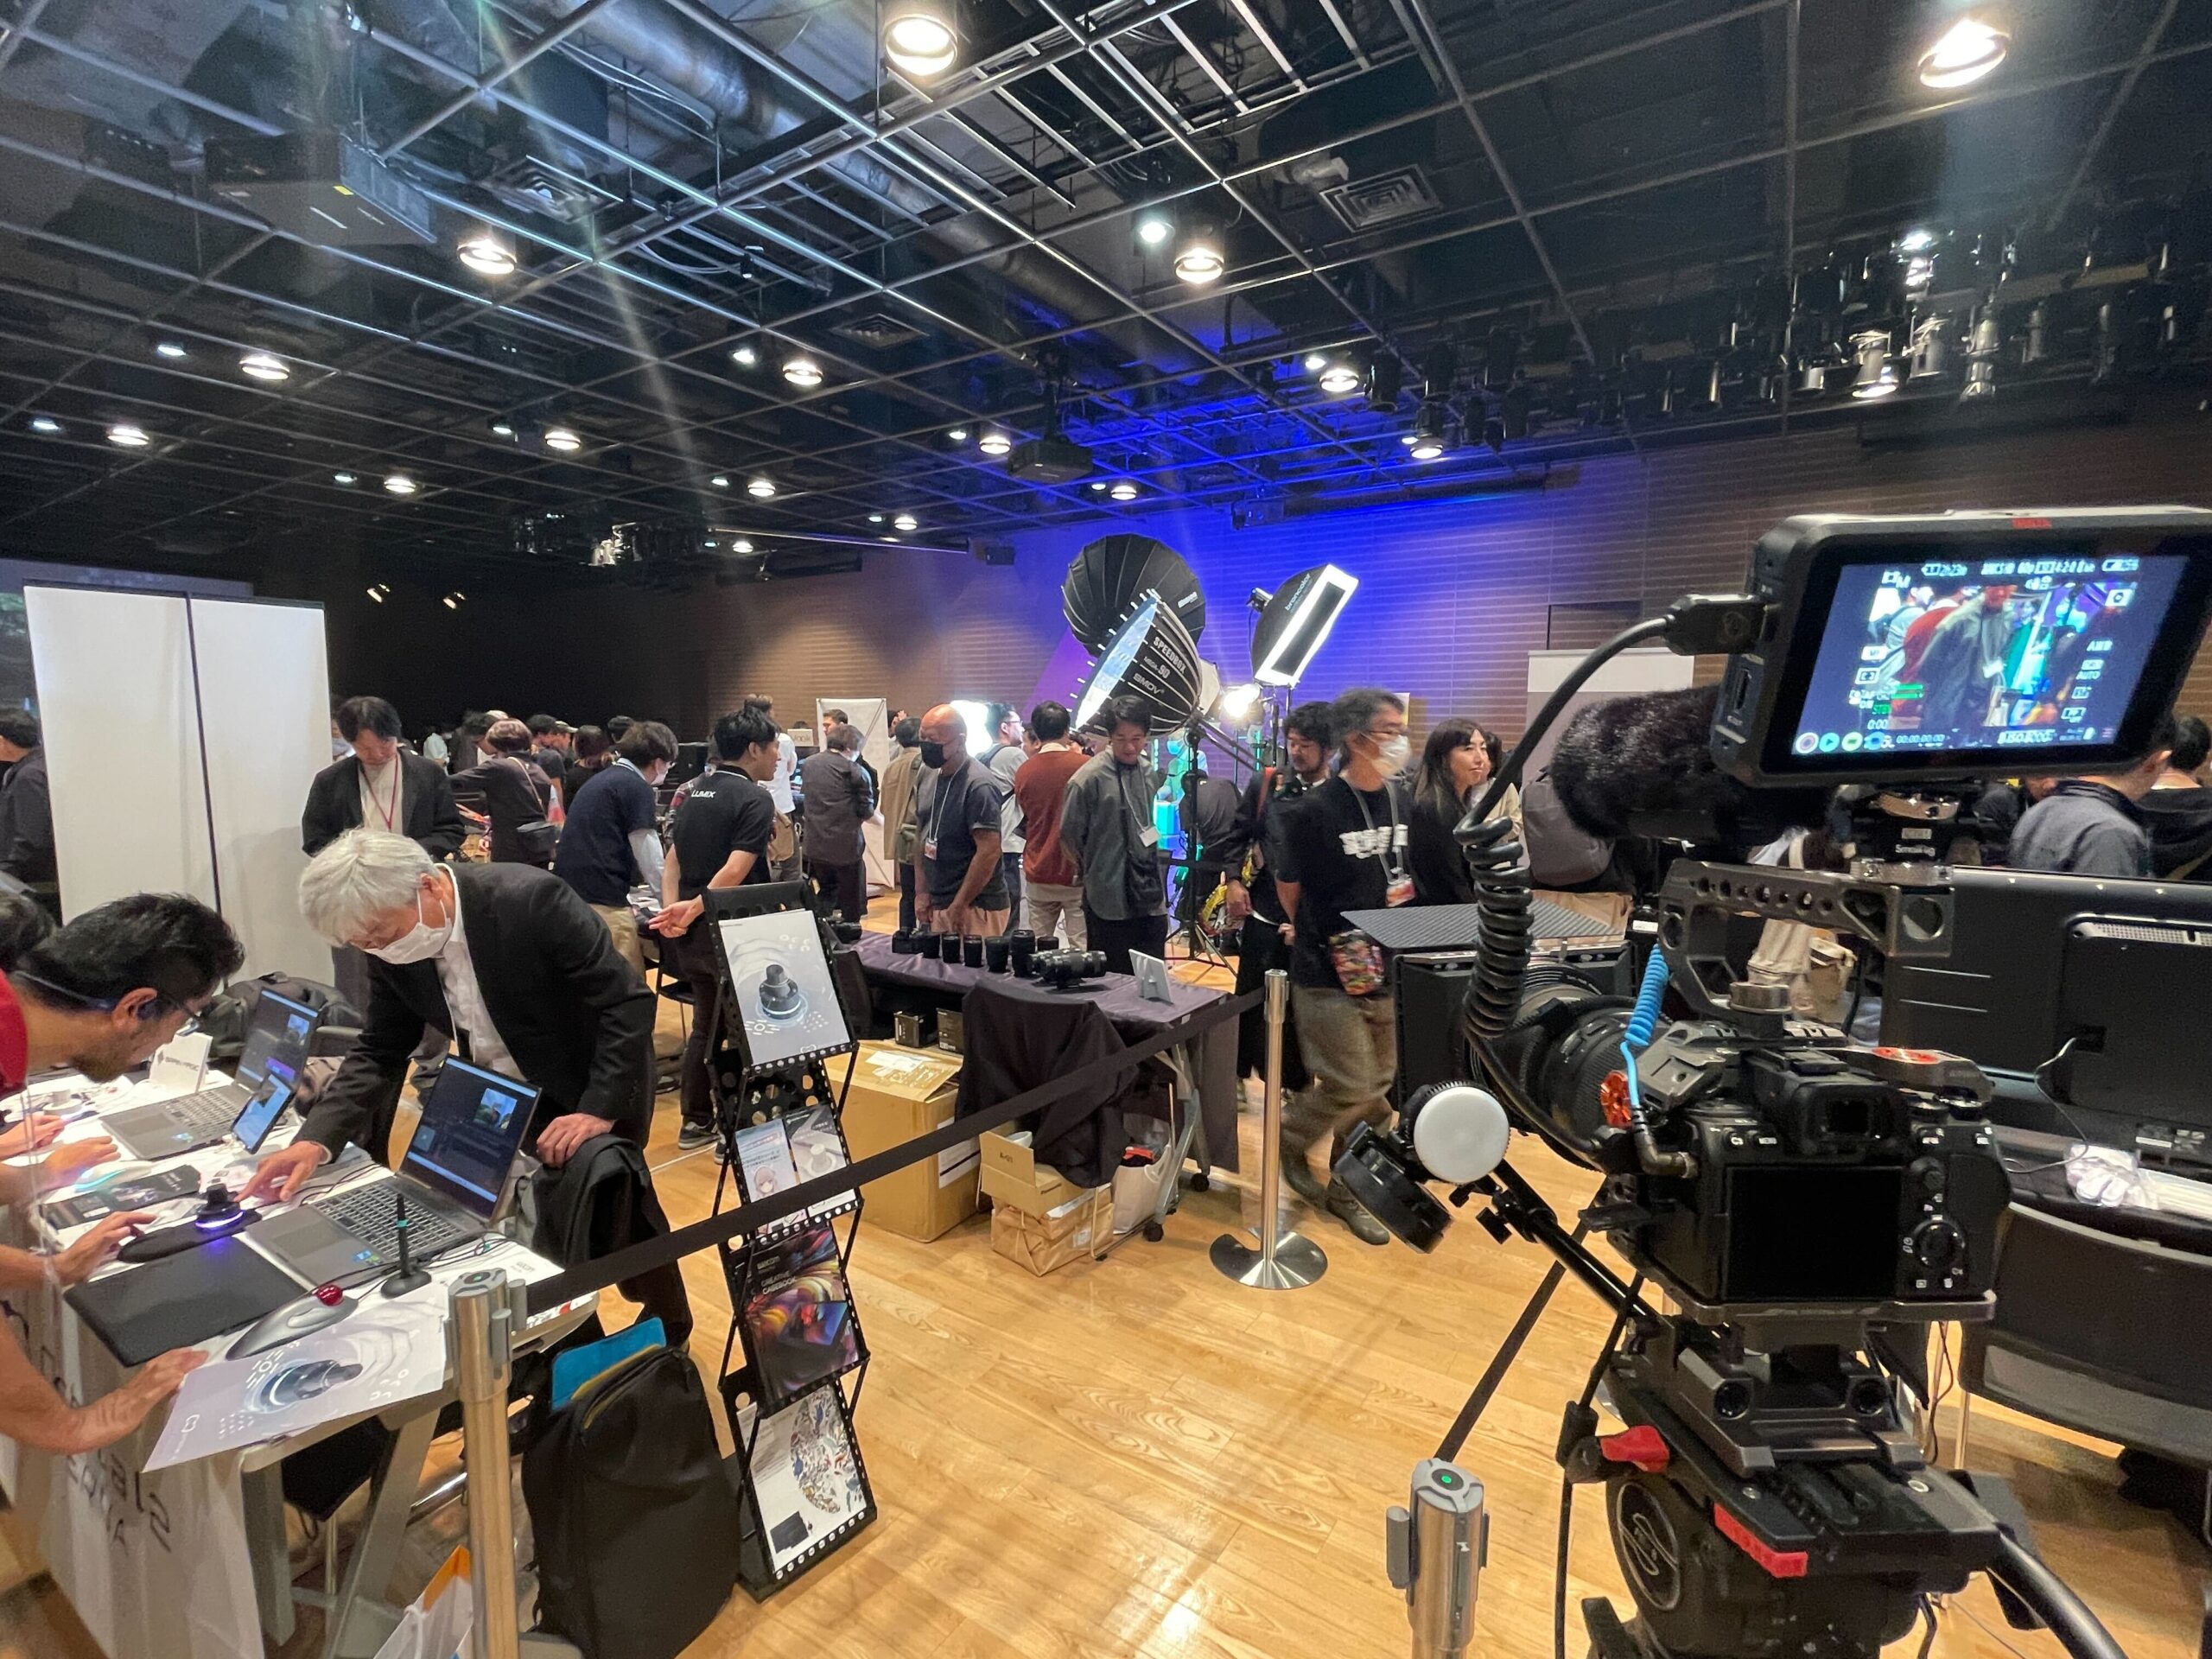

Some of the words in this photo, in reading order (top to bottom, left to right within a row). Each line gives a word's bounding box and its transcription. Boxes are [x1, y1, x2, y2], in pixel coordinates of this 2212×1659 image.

[1285, 573, 1310, 611] broncolor
[1153, 636, 1186, 674] SPEEDBOX
[690, 789, 716, 798] LUMIX
